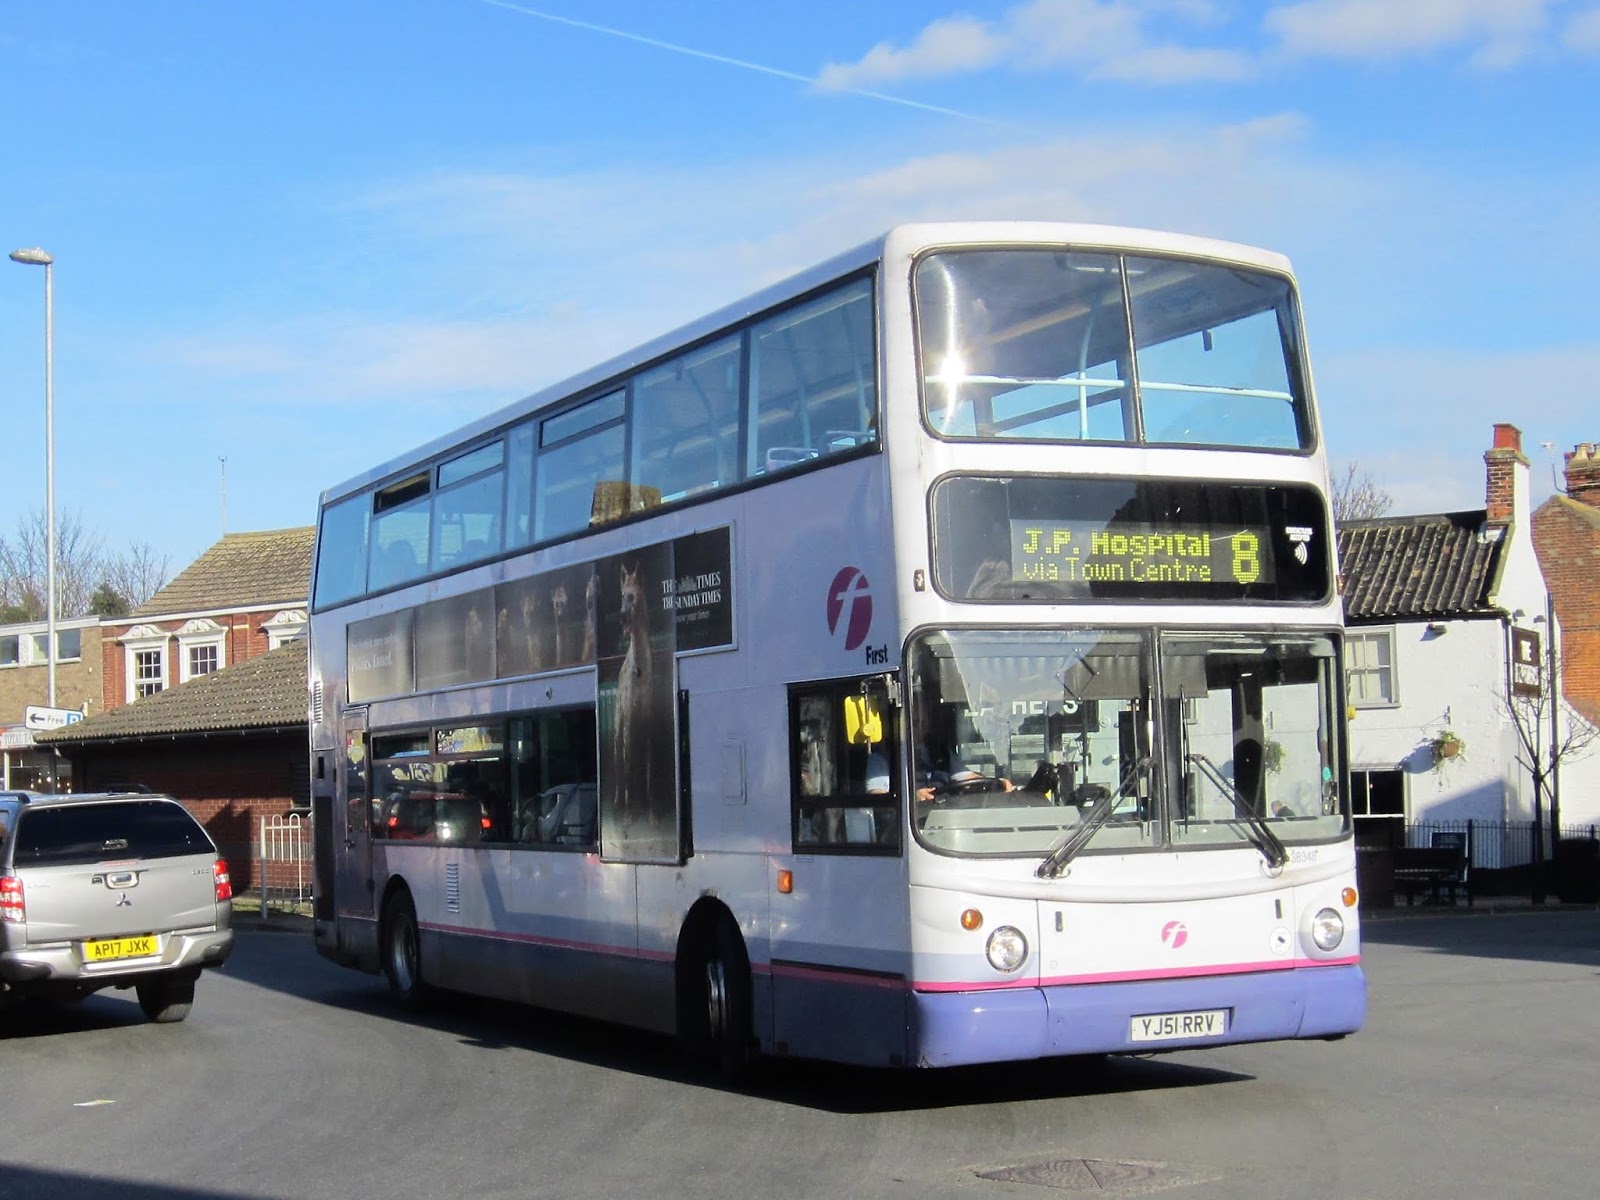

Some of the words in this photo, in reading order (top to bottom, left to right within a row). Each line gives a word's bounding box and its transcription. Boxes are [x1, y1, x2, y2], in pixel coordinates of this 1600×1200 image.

[1023, 530, 1080, 554] J.P.
[1091, 532, 1211, 556] Hospital
[1231, 533, 1260, 583] 8
[1023, 556, 1058, 580] via
[1064, 557, 1124, 580] Town
[1130, 557, 1211, 581] Centre
[696, 571, 721, 589] TIMES
[675, 593, 701, 609] SUNDAY
[701, 589, 721, 605] TIMES
[865, 644, 888, 665] First
[47, 715, 64, 724] Free
[95, 942, 121, 957] AP17
[127, 940, 150, 954] JXK
